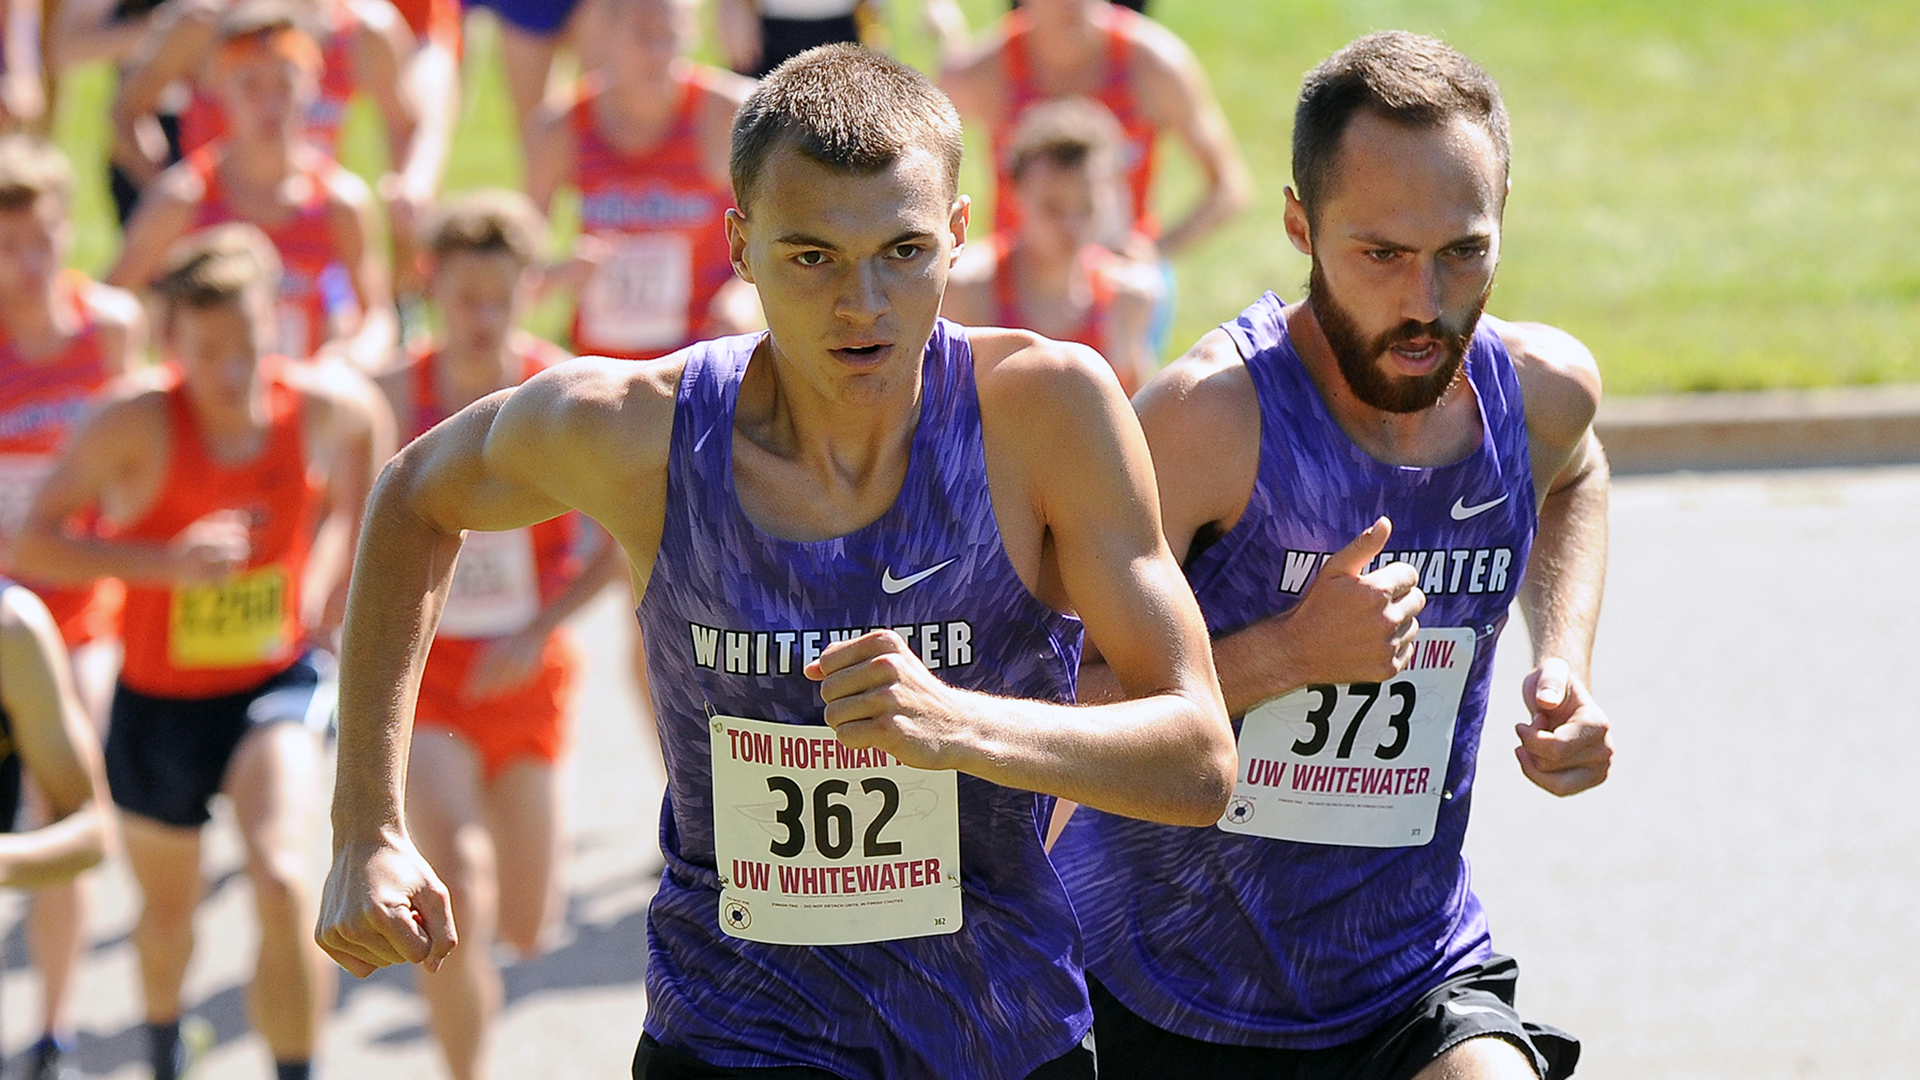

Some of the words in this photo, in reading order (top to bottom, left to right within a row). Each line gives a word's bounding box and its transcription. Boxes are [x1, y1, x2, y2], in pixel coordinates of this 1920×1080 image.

[1421, 640, 1456, 669] INV.
[1291, 681, 1416, 760] 373
[727, 728, 773, 765] TOM
[780, 736, 887, 769] HOFFMAN
[1247, 758, 1287, 787] UW
[1292, 764, 1430, 795] WHITEWATER
[766, 776, 902, 860] 362
[732, 859, 771, 891] UW
[778, 858, 941, 894] WHITEWATER
[934, 917, 946, 926] 362
